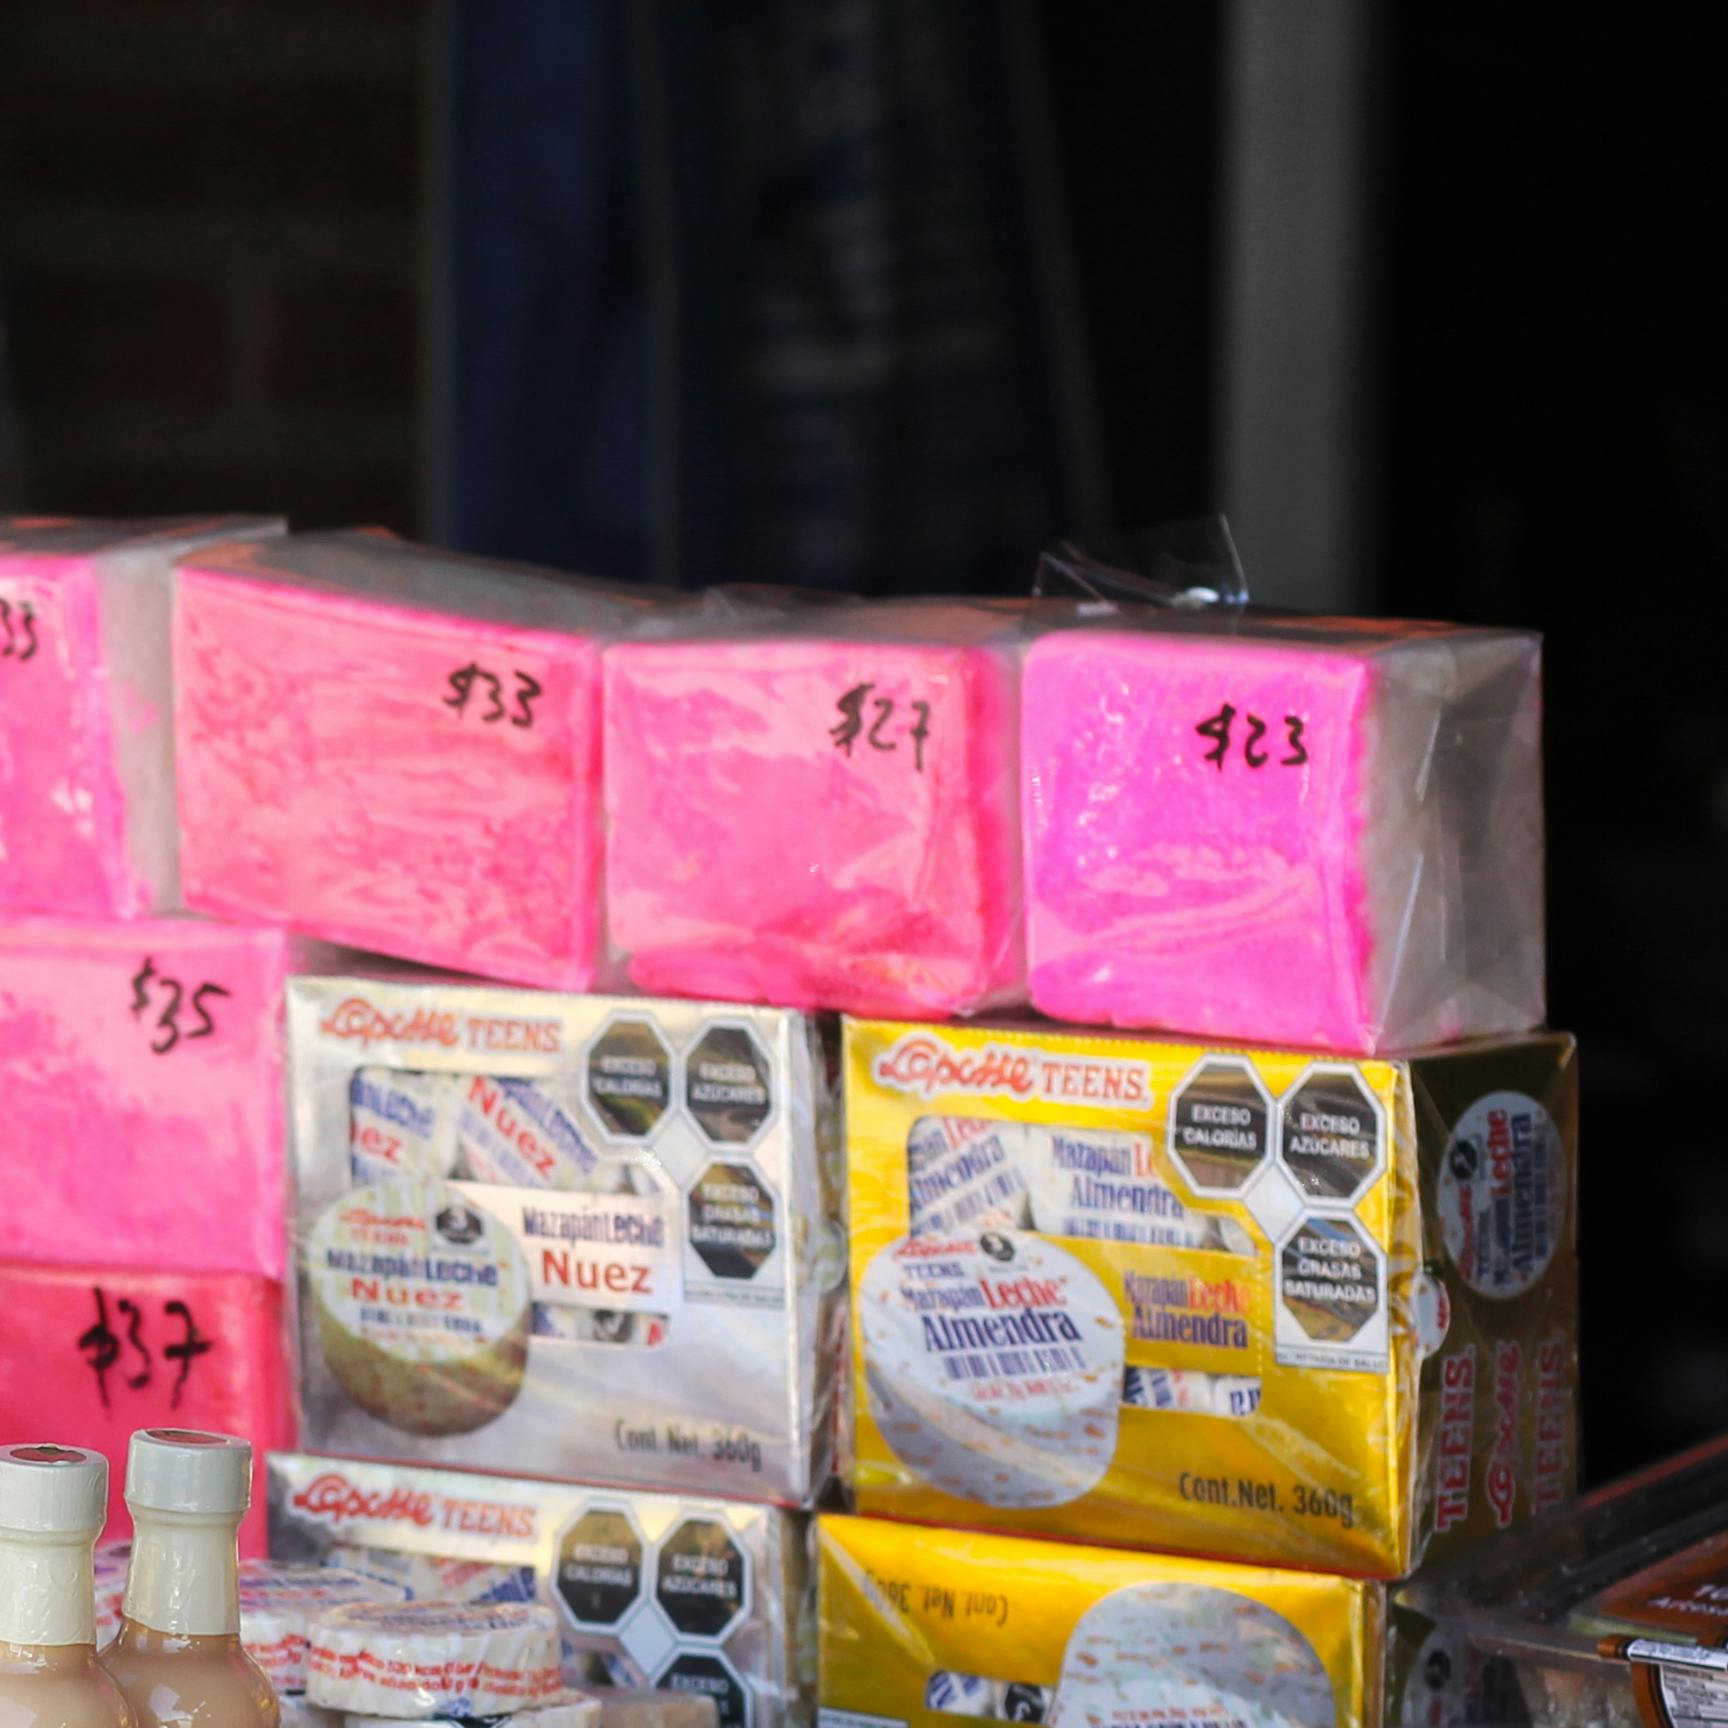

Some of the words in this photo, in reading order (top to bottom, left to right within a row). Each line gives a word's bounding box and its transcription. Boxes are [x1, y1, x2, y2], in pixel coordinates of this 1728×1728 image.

[442, 660, 543, 728] $33
[833, 681, 935, 773] $27
[1196, 702, 1310, 770] $23
[130, 956, 234, 1056] $35
[466, 1015, 561, 1053] TEENS
[1042, 1060, 1146, 1102] TEENS
[467, 1074, 558, 1184] Nuez
[1191, 1103, 1252, 1127] EXCESO
[1298, 1114, 1361, 1137] EXCESO
[1297, 1236, 1361, 1257] EXCESO
[541, 1248, 654, 1294] Nuez
[1297, 1258, 1362, 1280] GRASAS
[351, 1276, 464, 1310] Nuez
[1284, 1282, 1377, 1303] SATURADAS
[923, 1308, 1082, 1353] Almendra
[1130, 1306, 1249, 1350] Almendra
[76, 1285, 214, 1420] $37
[1436, 1355, 1475, 1533] TEENS
[443, 1501, 534, 1538] TEENS
[1291, 1484, 1355, 1530] 360g
[671, 1553, 730, 1576] EXCESO
